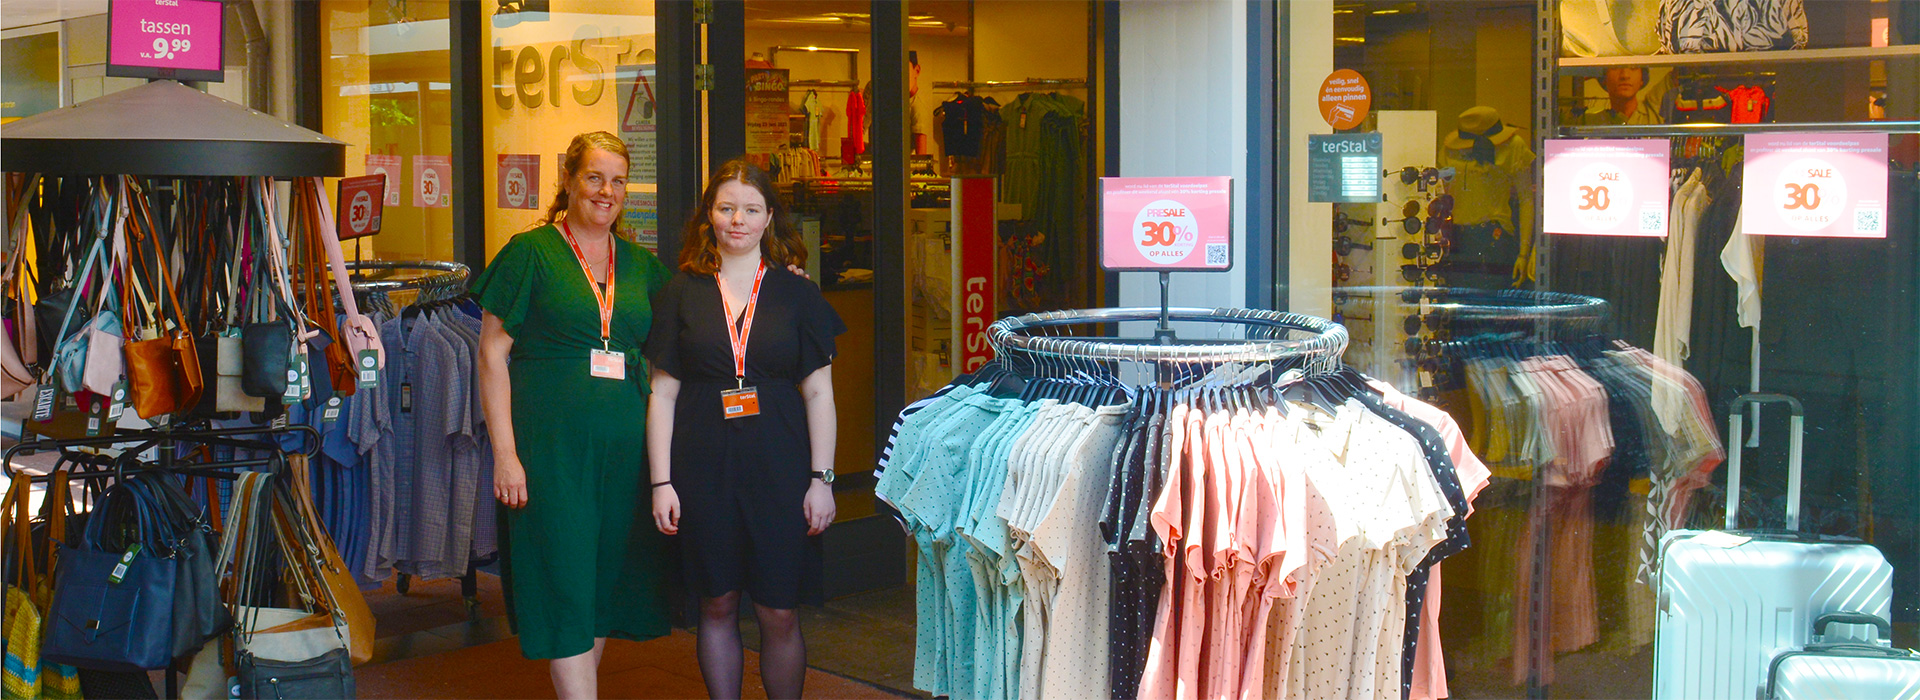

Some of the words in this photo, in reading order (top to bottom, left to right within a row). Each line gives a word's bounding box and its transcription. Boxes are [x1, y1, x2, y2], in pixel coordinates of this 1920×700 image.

[140, 19, 191, 35] tassen
[1329, 78, 1346, 86] veilig,
[1333, 85, 1364, 94] eenvoudig
[1343, 93, 1367, 102] pinnen
[1322, 140, 1367, 153] terStal
[1147, 208, 1185, 217] PRESALE
[1141, 221, 1193, 247] 30%
